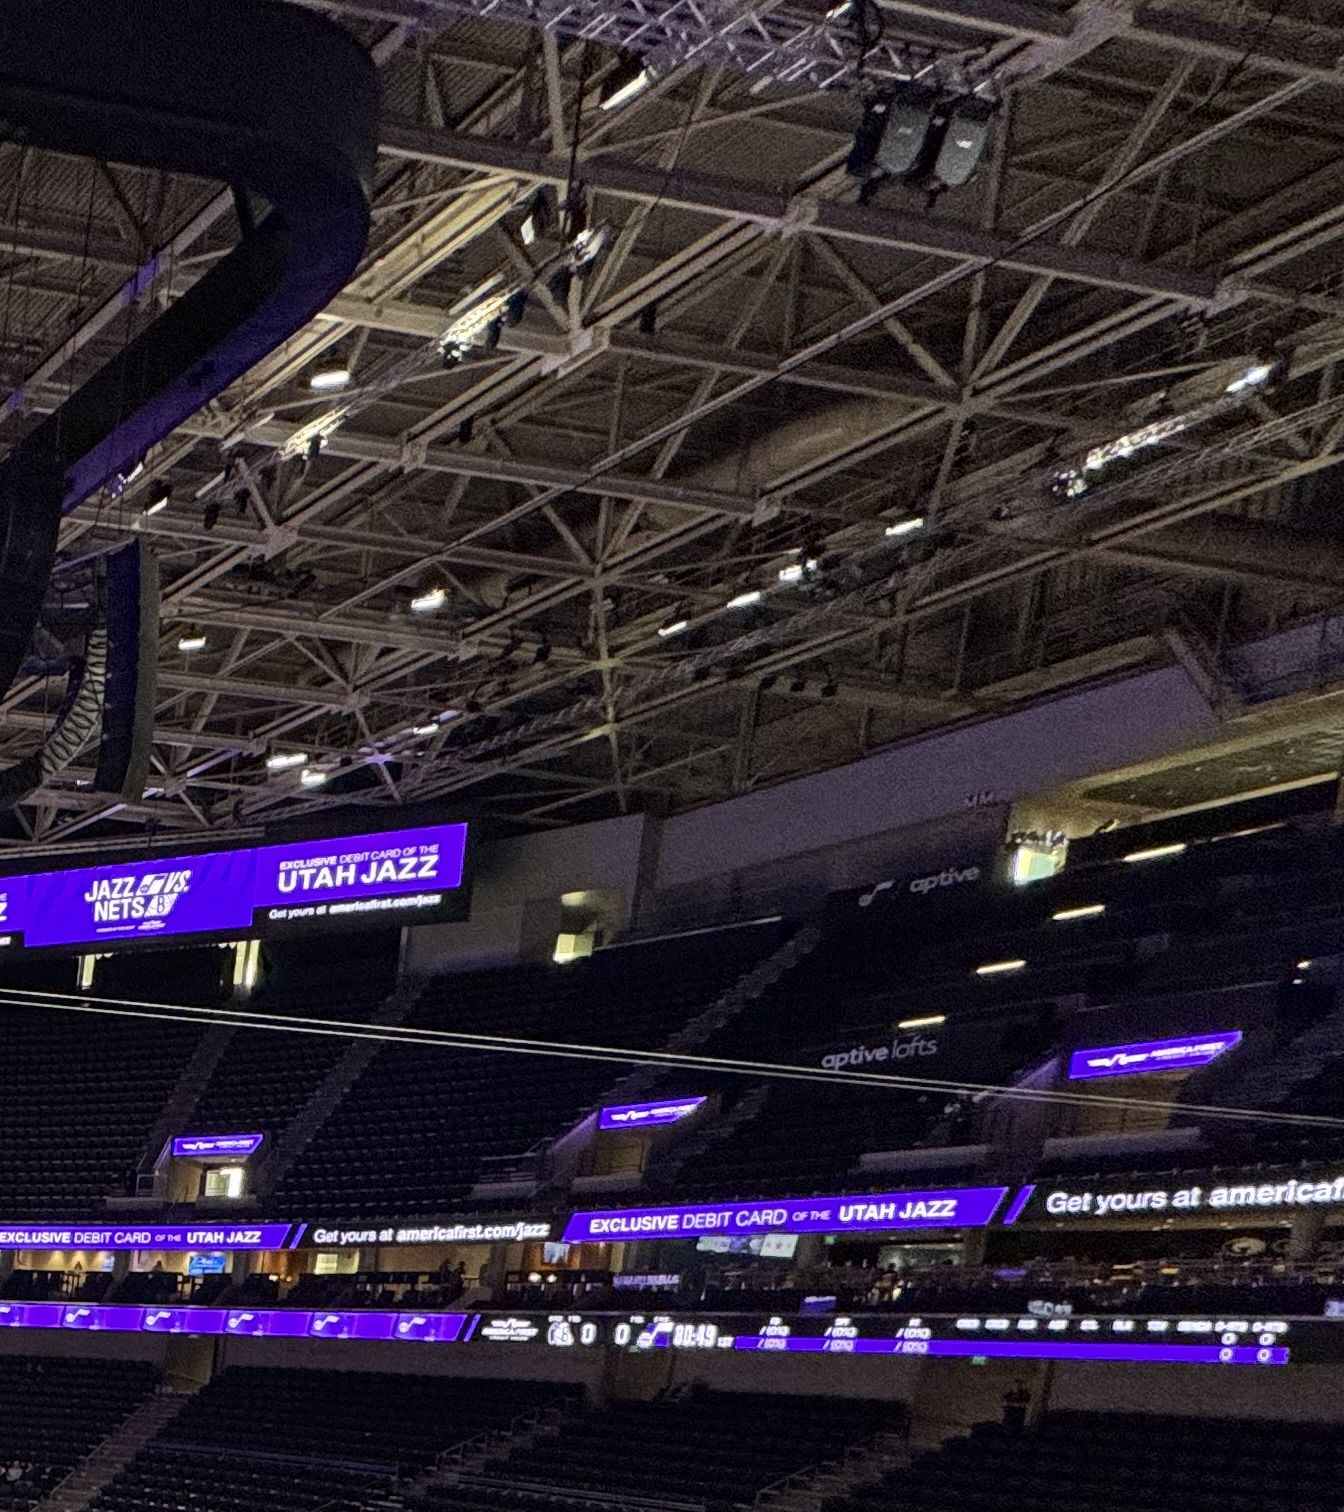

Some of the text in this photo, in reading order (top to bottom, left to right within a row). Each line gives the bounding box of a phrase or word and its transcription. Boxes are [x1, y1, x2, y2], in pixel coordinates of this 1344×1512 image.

[279, 856, 338, 871] EXCLUSIVE
[403, 846, 417, 856] OF
[419, 844, 439, 854] THE
[85, 870, 192, 902] JAZZ VS.
[278, 854, 439, 892] UTAH JAZZ
[910, 867, 980, 894] aptive
[94, 899, 145, 922] NETS
[822, 1034, 939, 1070] aptive lofts
[1047, 1190, 1092, 1213] Get
[1094, 1190, 1169, 1214] yours
[1171, 1186, 1203, 1207] at
[589, 1214, 679, 1233] EXCLUSIVE
[681, 1210, 732, 1229] DEBIT
[735, 1208, 788, 1227] CARD
[839, 1202, 894, 1222] UTAH
[898, 1199, 957, 1219] JAZZ
[73, 1231, 112, 1243] DEBIT
[113, 1231, 152, 1243] CARD
[186, 1231, 226, 1243] UTAH
[226, 1230, 262, 1243] JAZZ
[314, 1222, 550, 1244] Get yours at americafirst.com/jazz
[580, 1323, 598, 1345] 0
[615, 1323, 630, 1344] 0
